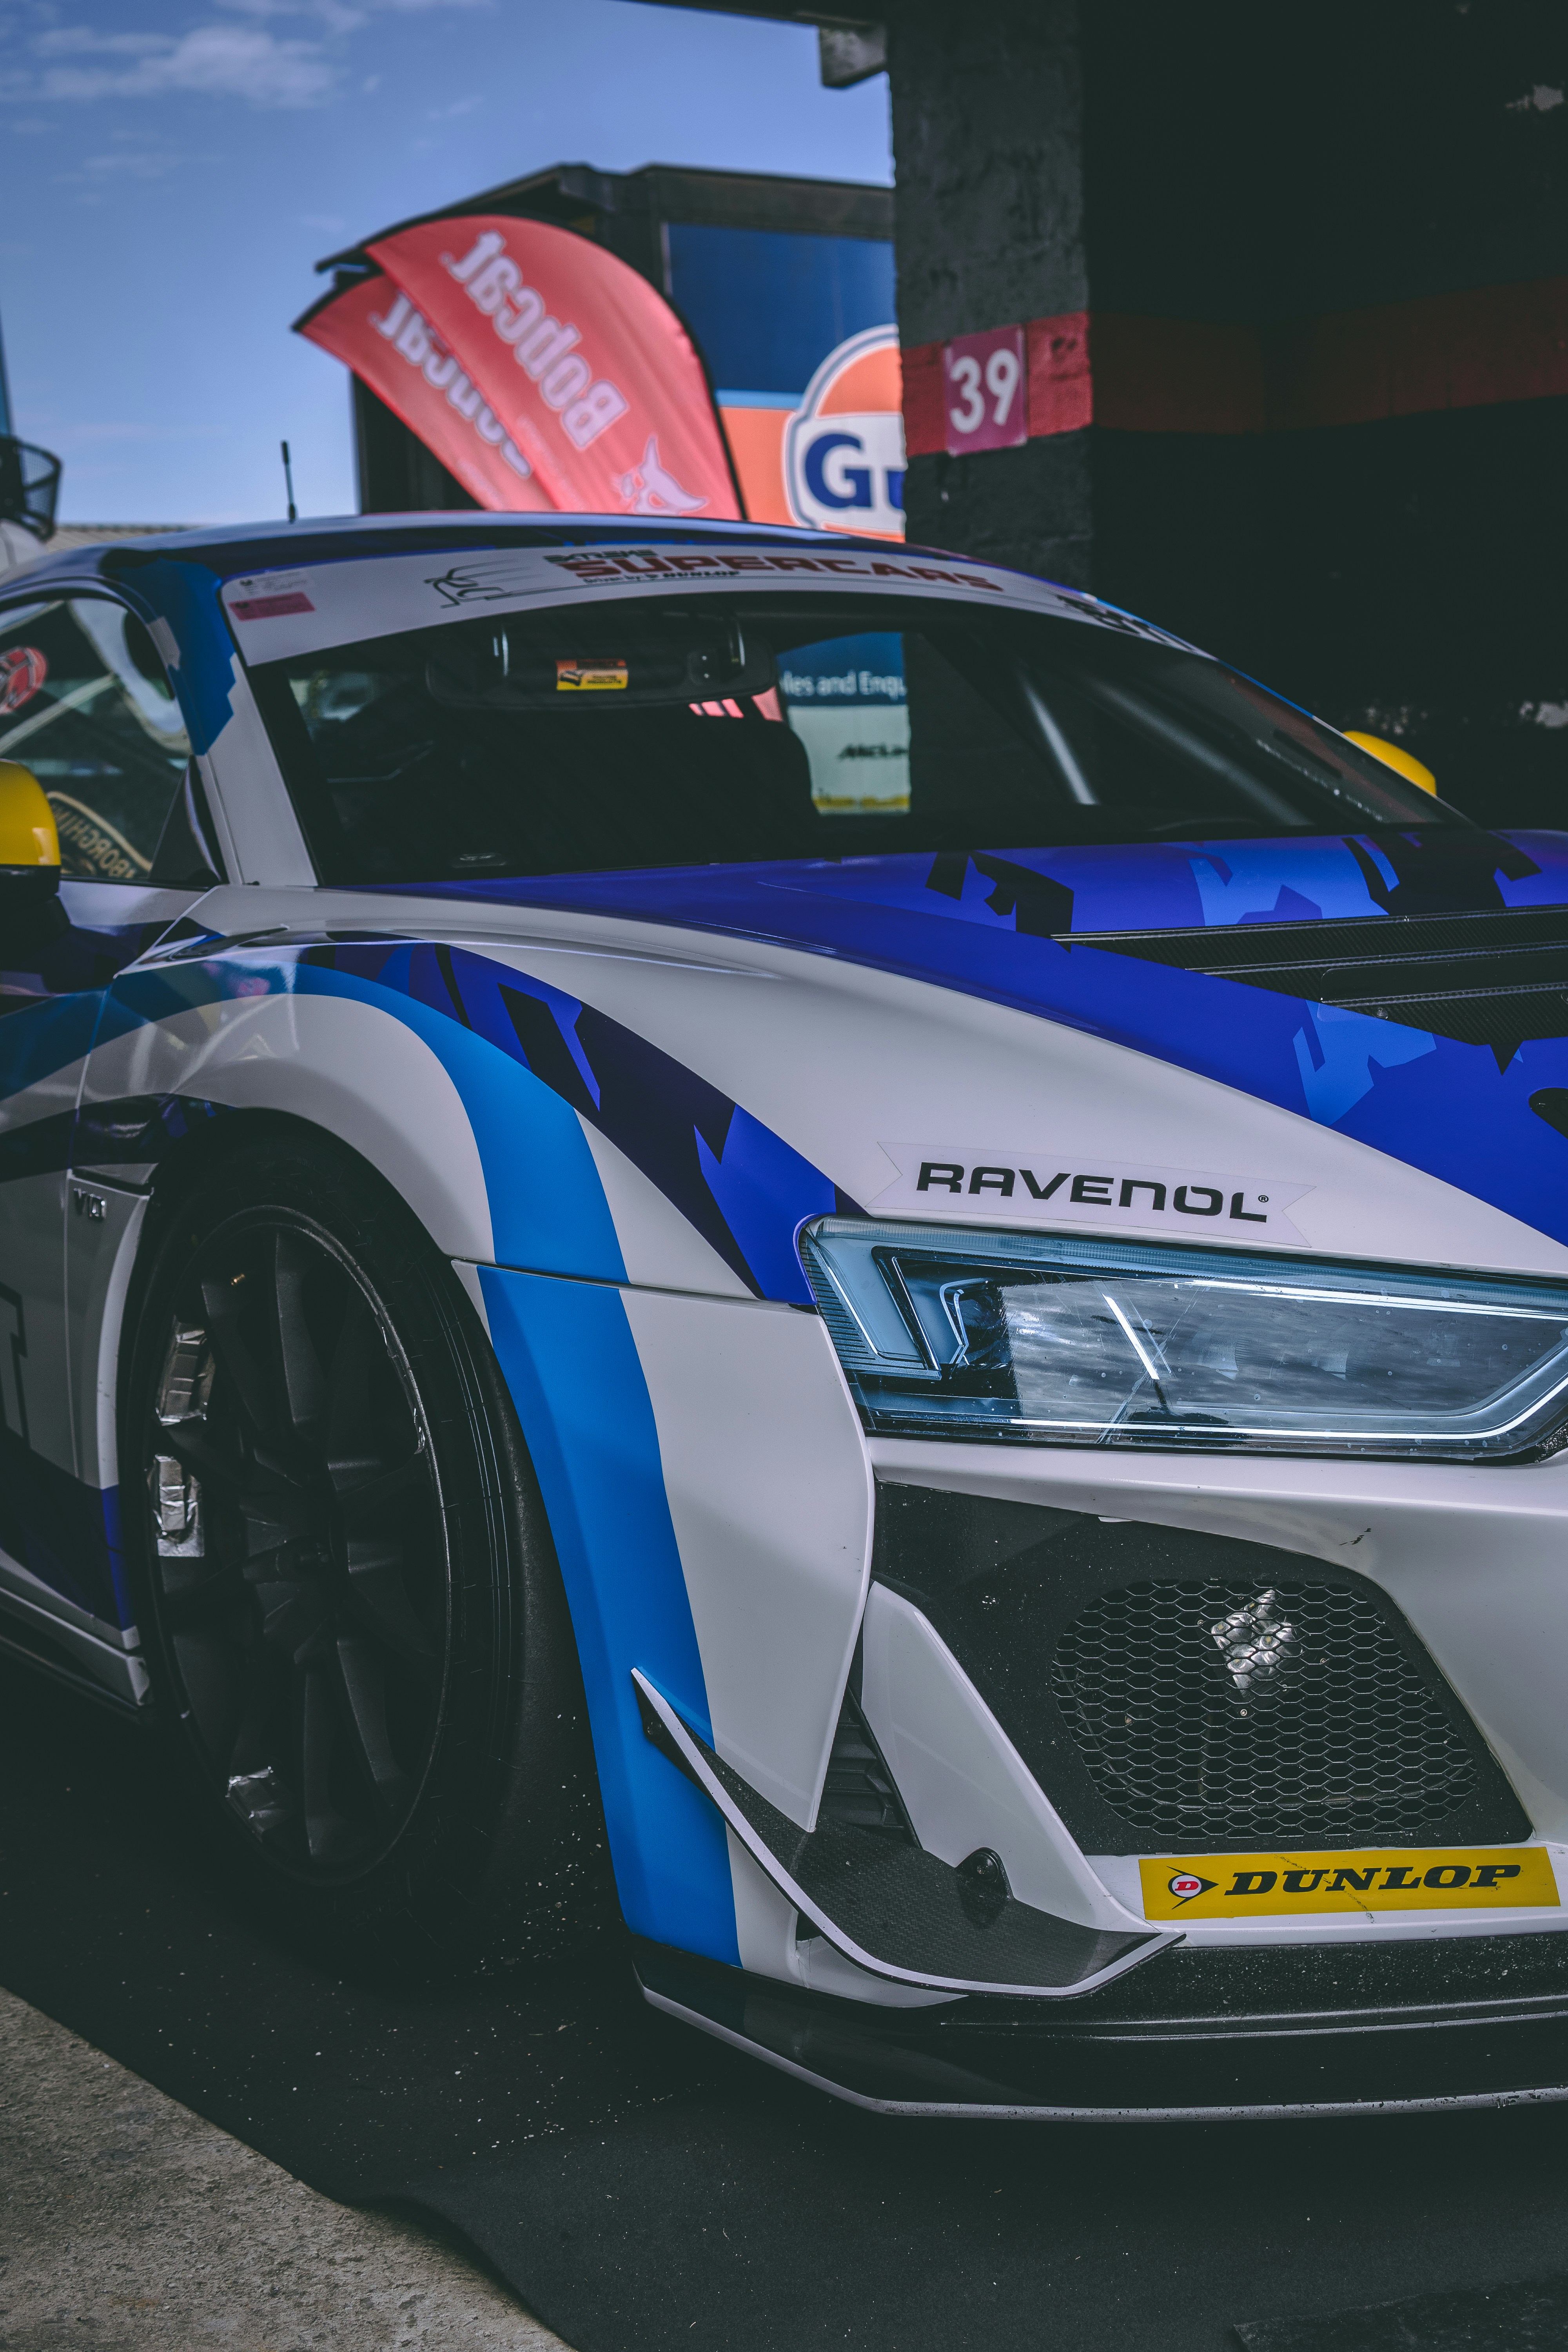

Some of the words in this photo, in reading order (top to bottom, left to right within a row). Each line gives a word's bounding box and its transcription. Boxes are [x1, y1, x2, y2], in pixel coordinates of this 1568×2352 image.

[949, 348, 1019, 433] 39
[557, 555, 1004, 592] SUPERCARS
[817, 668, 858, 697] and
[1174, 1881, 1199, 1891] D
[1224, 1864, 1521, 1896] DUNLOP
